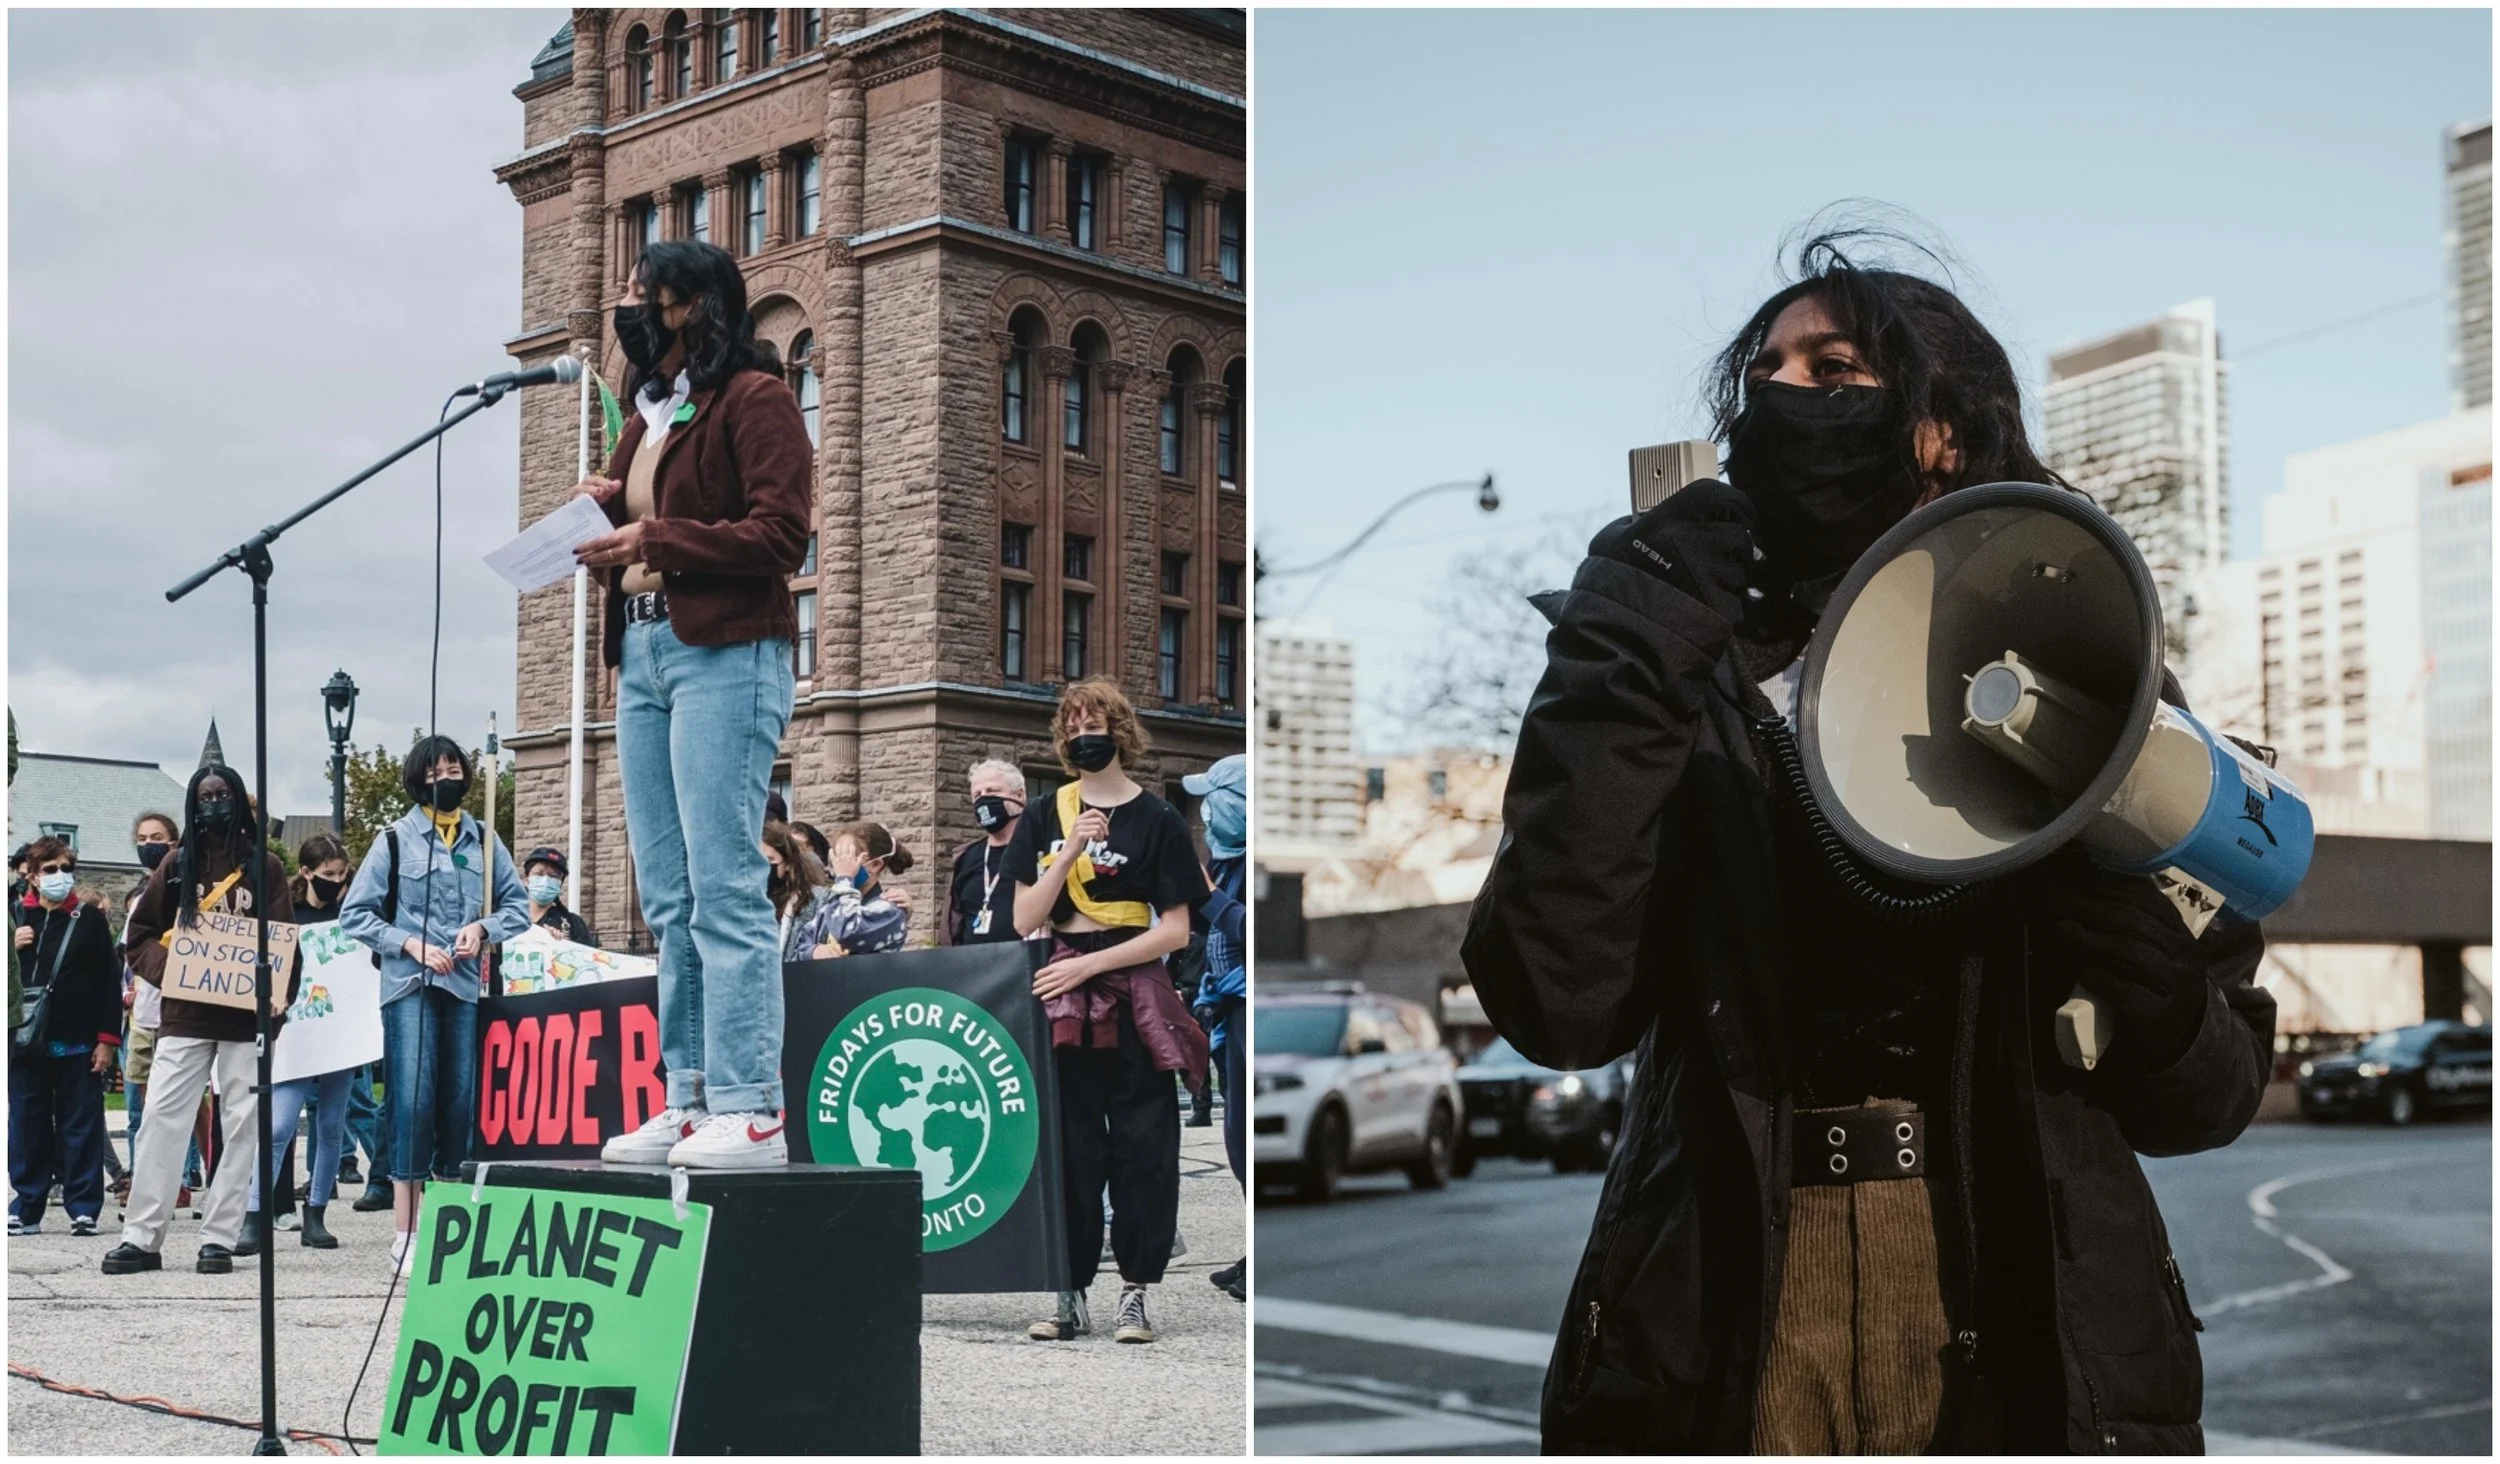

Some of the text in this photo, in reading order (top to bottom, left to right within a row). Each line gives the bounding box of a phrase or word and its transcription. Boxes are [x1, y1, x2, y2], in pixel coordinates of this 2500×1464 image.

[1632, 539, 1672, 569] HEAD
[175, 937, 209, 958] ON
[179, 964, 255, 995] LAND
[480, 1009, 602, 1145] CODE
[819, 1002, 1025, 1124] FRIDAYS FOR FUTURE
[428, 1194, 683, 1298] PLANET
[465, 1293, 594, 1365] OVER
[391, 1339, 637, 1456] PROFIT
